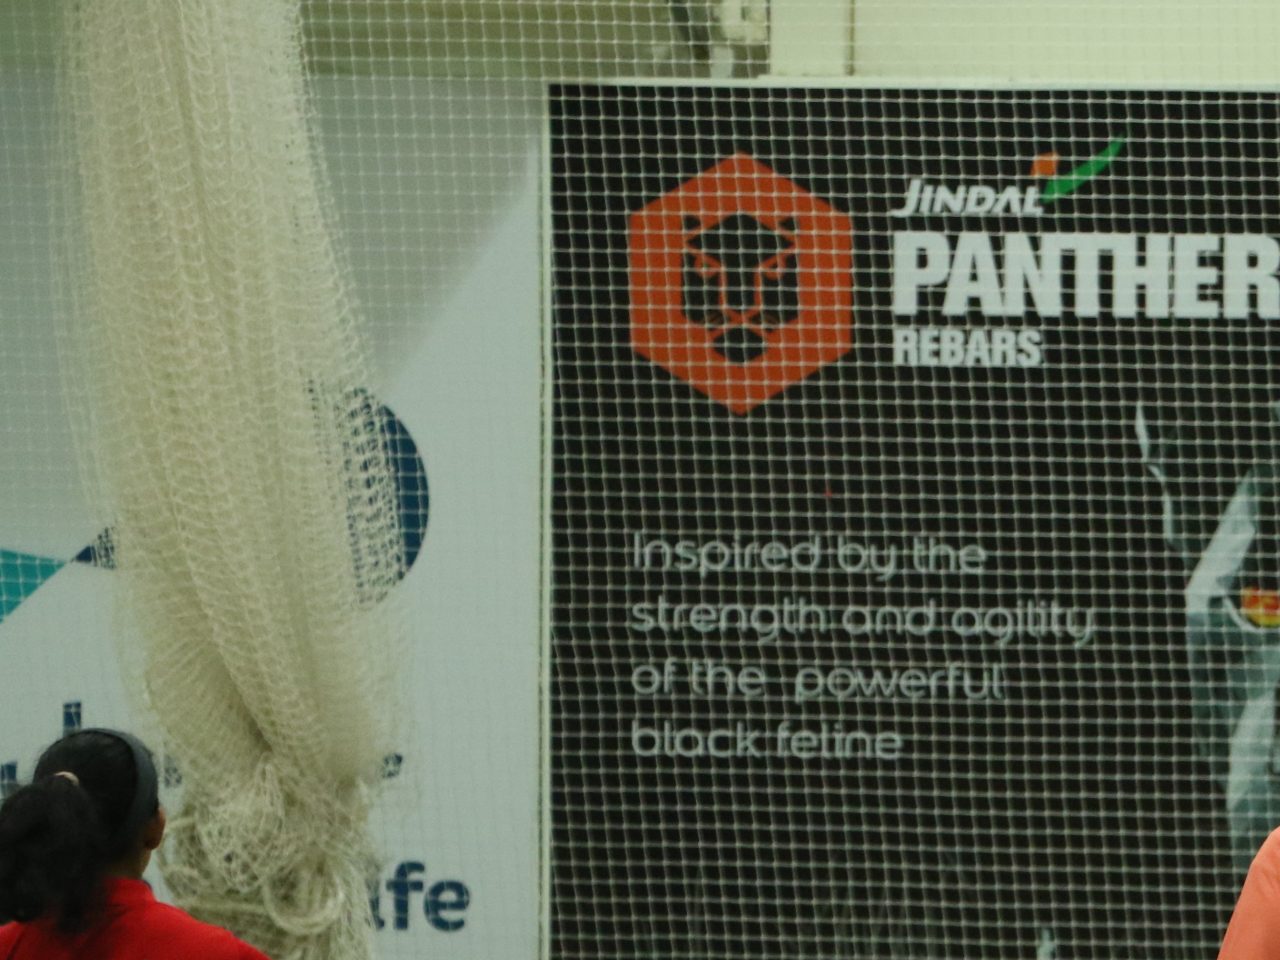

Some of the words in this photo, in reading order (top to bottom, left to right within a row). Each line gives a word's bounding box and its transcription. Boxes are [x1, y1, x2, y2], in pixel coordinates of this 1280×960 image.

[891, 179, 1045, 217] JINDAL
[893, 328, 1043, 368] REBARS
[632, 532, 820, 577] Inspired
[838, 534, 898, 580] by
[913, 536, 987, 574] the
[631, 596, 825, 644] strength
[842, 600, 936, 636] and
[952, 601, 1096, 647] agility
[631, 658, 676, 694] of
[691, 660, 765, 696] the
[795, 662, 1003, 703] powerful
[631, 722, 761, 758] black
[776, 723, 902, 761] feline
